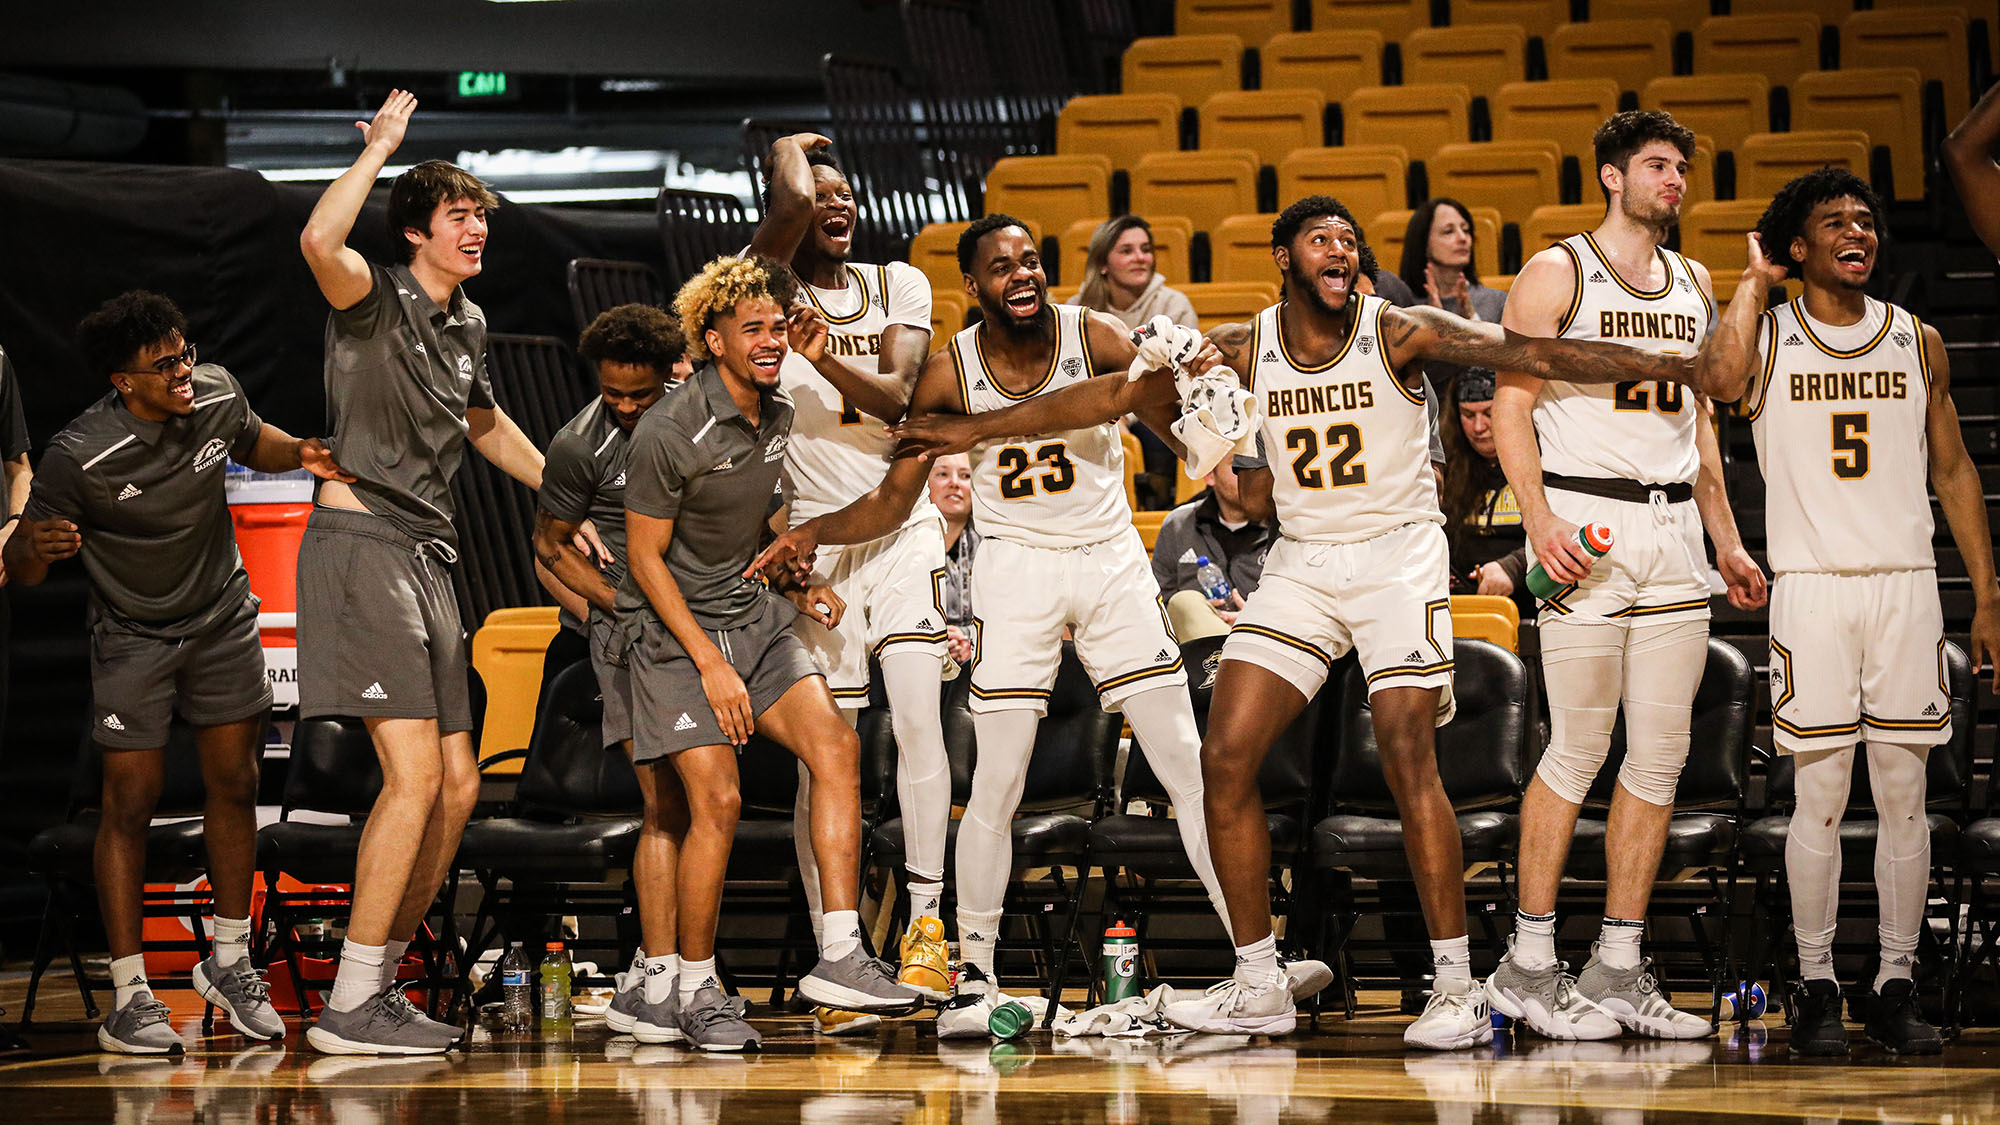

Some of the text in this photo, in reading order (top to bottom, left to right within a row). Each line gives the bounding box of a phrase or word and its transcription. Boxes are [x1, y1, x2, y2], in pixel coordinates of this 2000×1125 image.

[1600, 311, 1697, 344] BRONCOS
[1267, 380, 1375, 418] BRONCOS
[1790, 371, 1908, 402] BRONCOS
[1284, 421, 1369, 491] 22
[1830, 411, 1871, 481] 5
[997, 441, 1076, 500] 23
[118, 489, 143, 501] adidas
[361, 691, 388, 699] adidas
[674, 721, 697, 731] adidas
